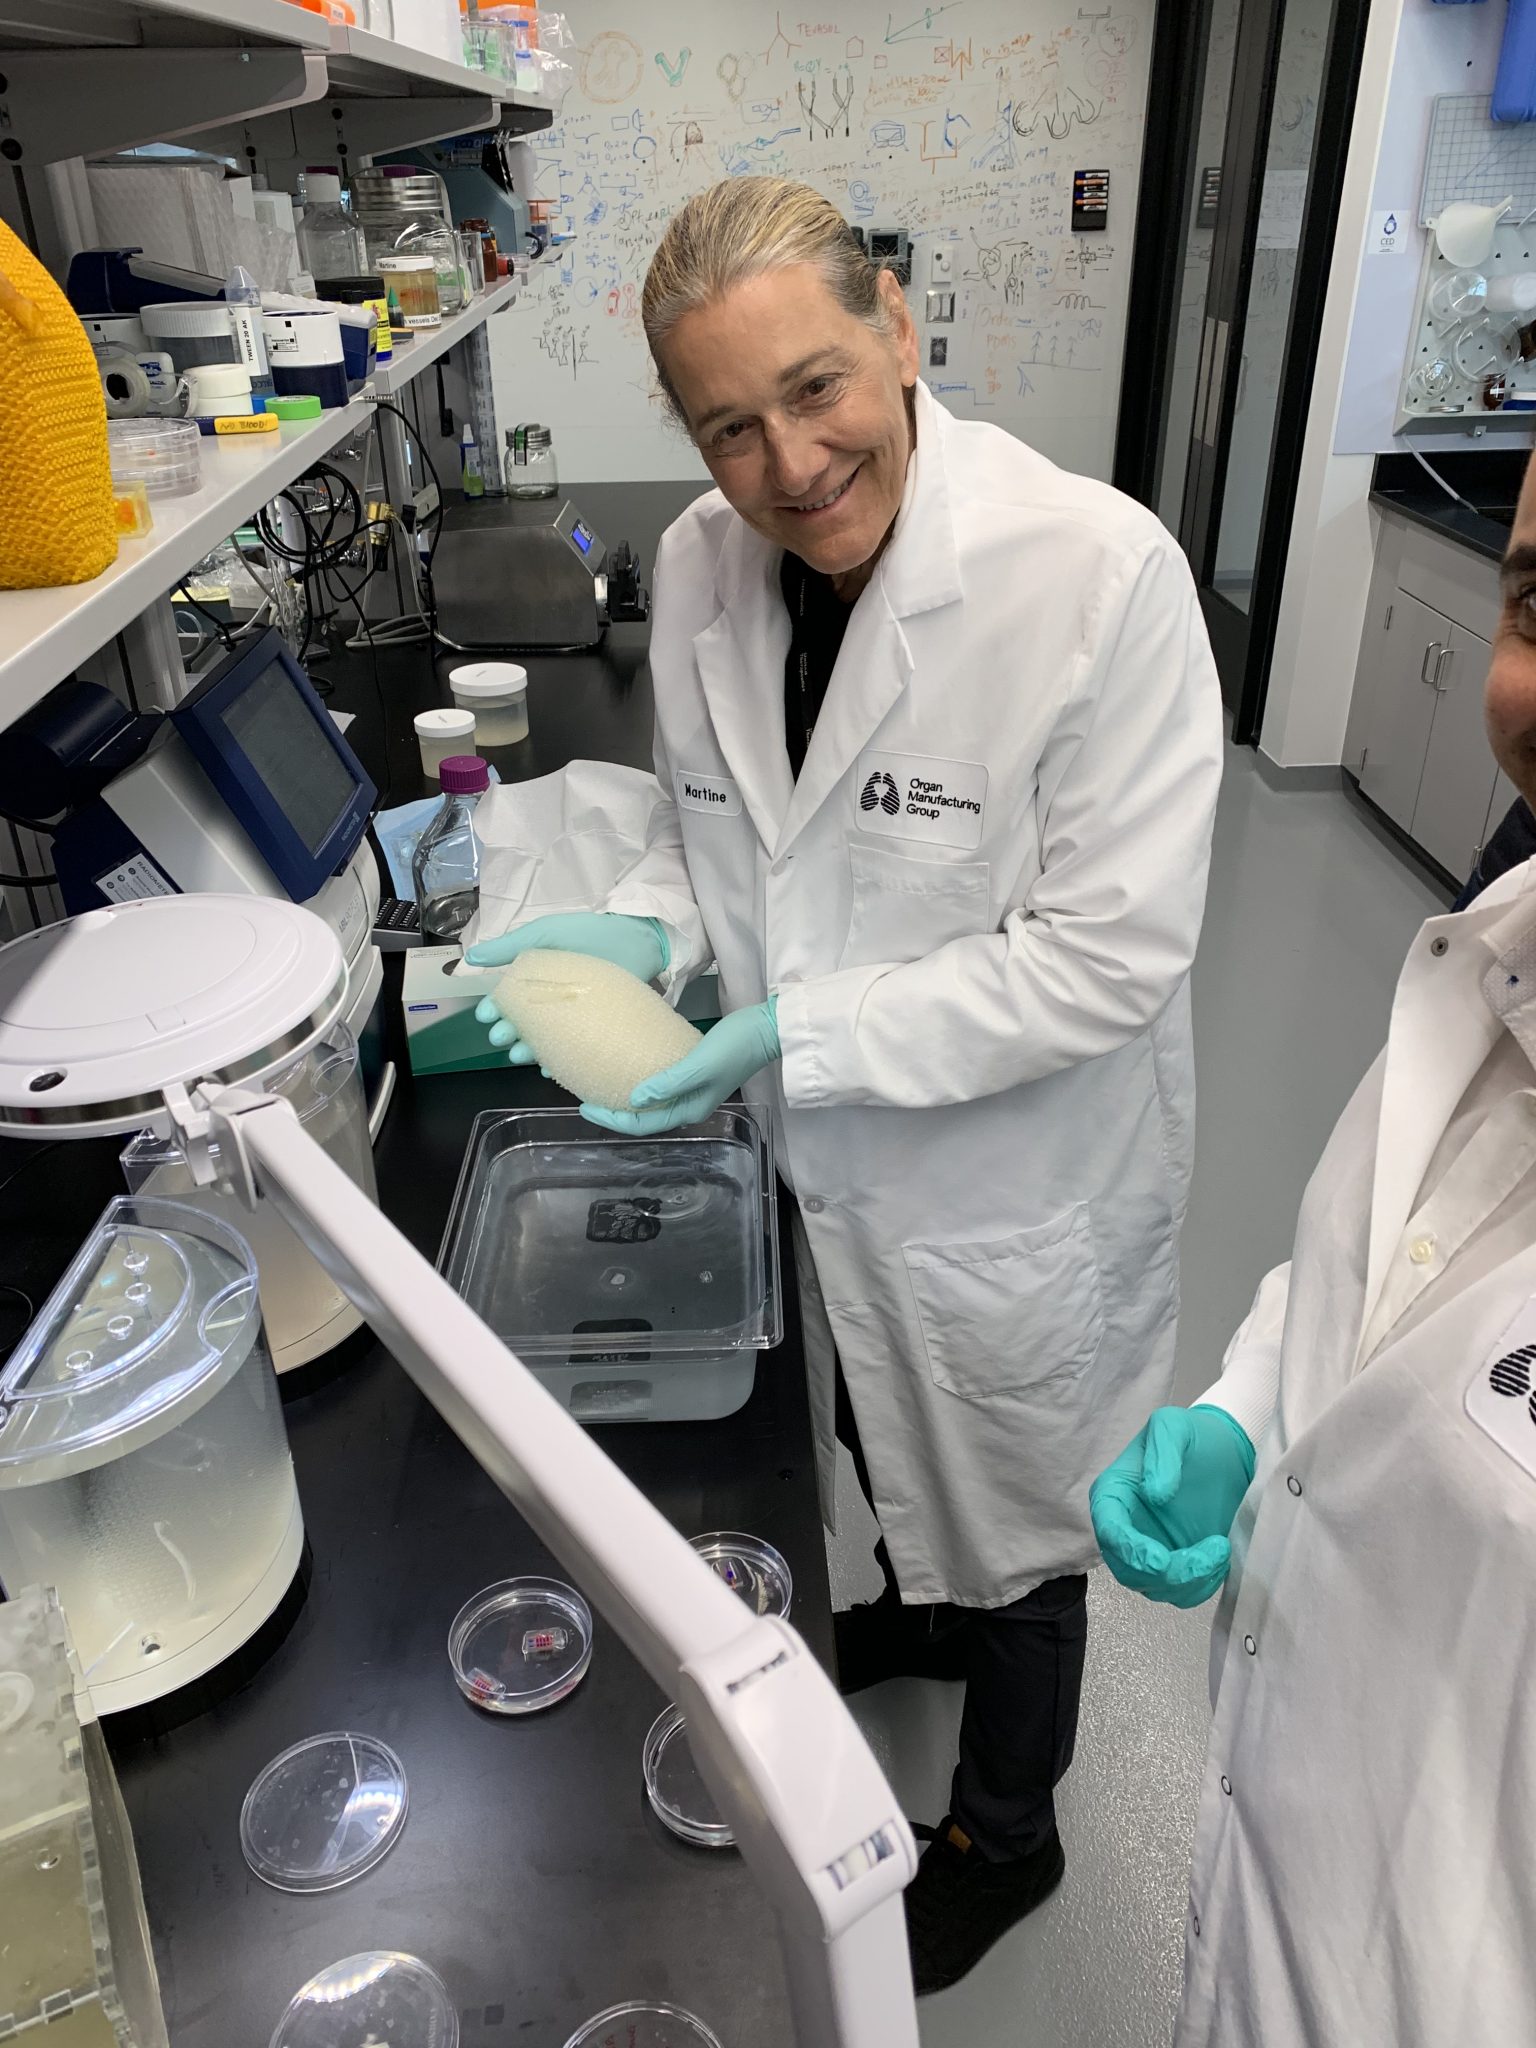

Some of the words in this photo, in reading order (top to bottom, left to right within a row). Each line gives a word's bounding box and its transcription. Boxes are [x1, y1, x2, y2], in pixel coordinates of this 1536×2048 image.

[243, 330, 250, 339] 20
[245, 339, 254, 362] TWEEN
[685, 783, 727, 803] Martine
[910, 778, 943, 795] Organ
[907, 790, 981, 814] Manufacturing
[906, 803, 940, 820] Group
